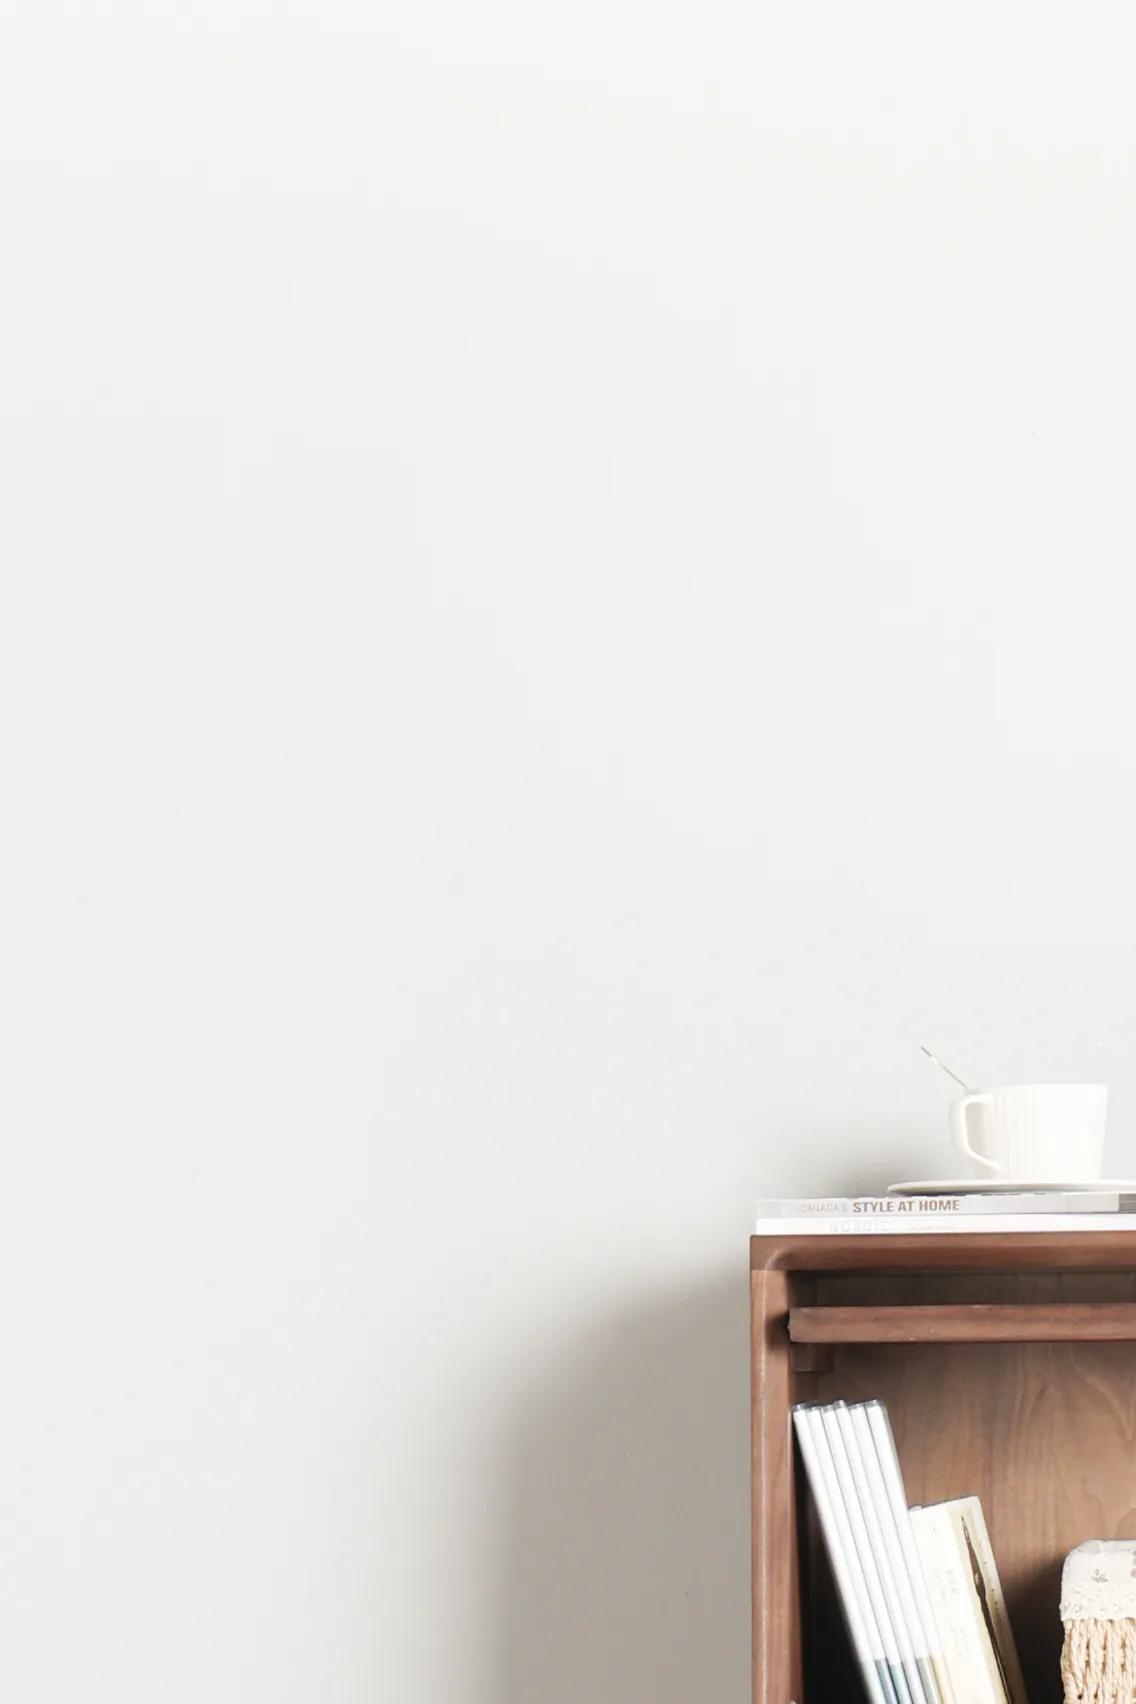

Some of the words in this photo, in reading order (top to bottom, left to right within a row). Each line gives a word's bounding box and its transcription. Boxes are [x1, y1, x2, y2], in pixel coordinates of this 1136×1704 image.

[852, 1200, 894, 1213] STYLE
[897, 1200, 915, 1212] AT
[918, 1199, 960, 1212] HOME
